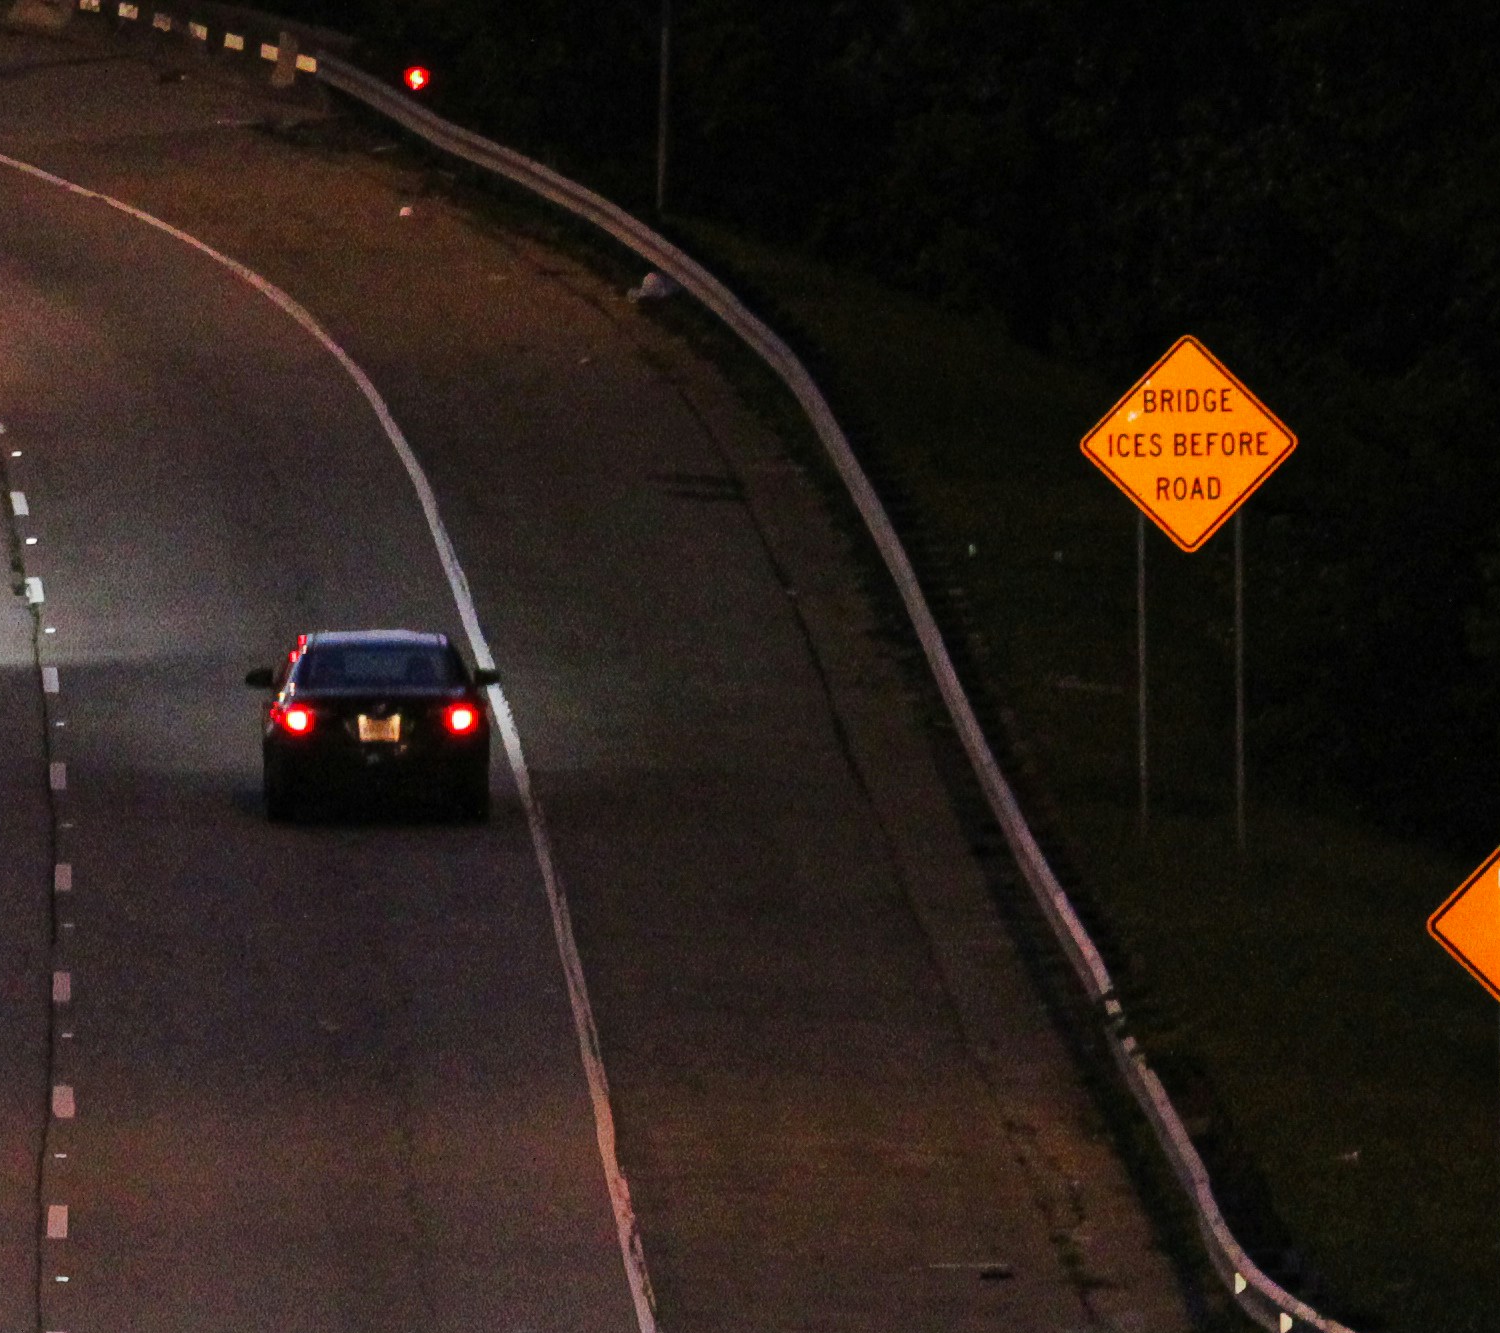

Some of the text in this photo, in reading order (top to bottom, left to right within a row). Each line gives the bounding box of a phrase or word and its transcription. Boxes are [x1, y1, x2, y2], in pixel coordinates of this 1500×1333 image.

[1143, 388, 1233, 413] BRIDGE
[1108, 431, 1270, 458] ICES BEFORE
[1156, 476, 1222, 501] ROAD
